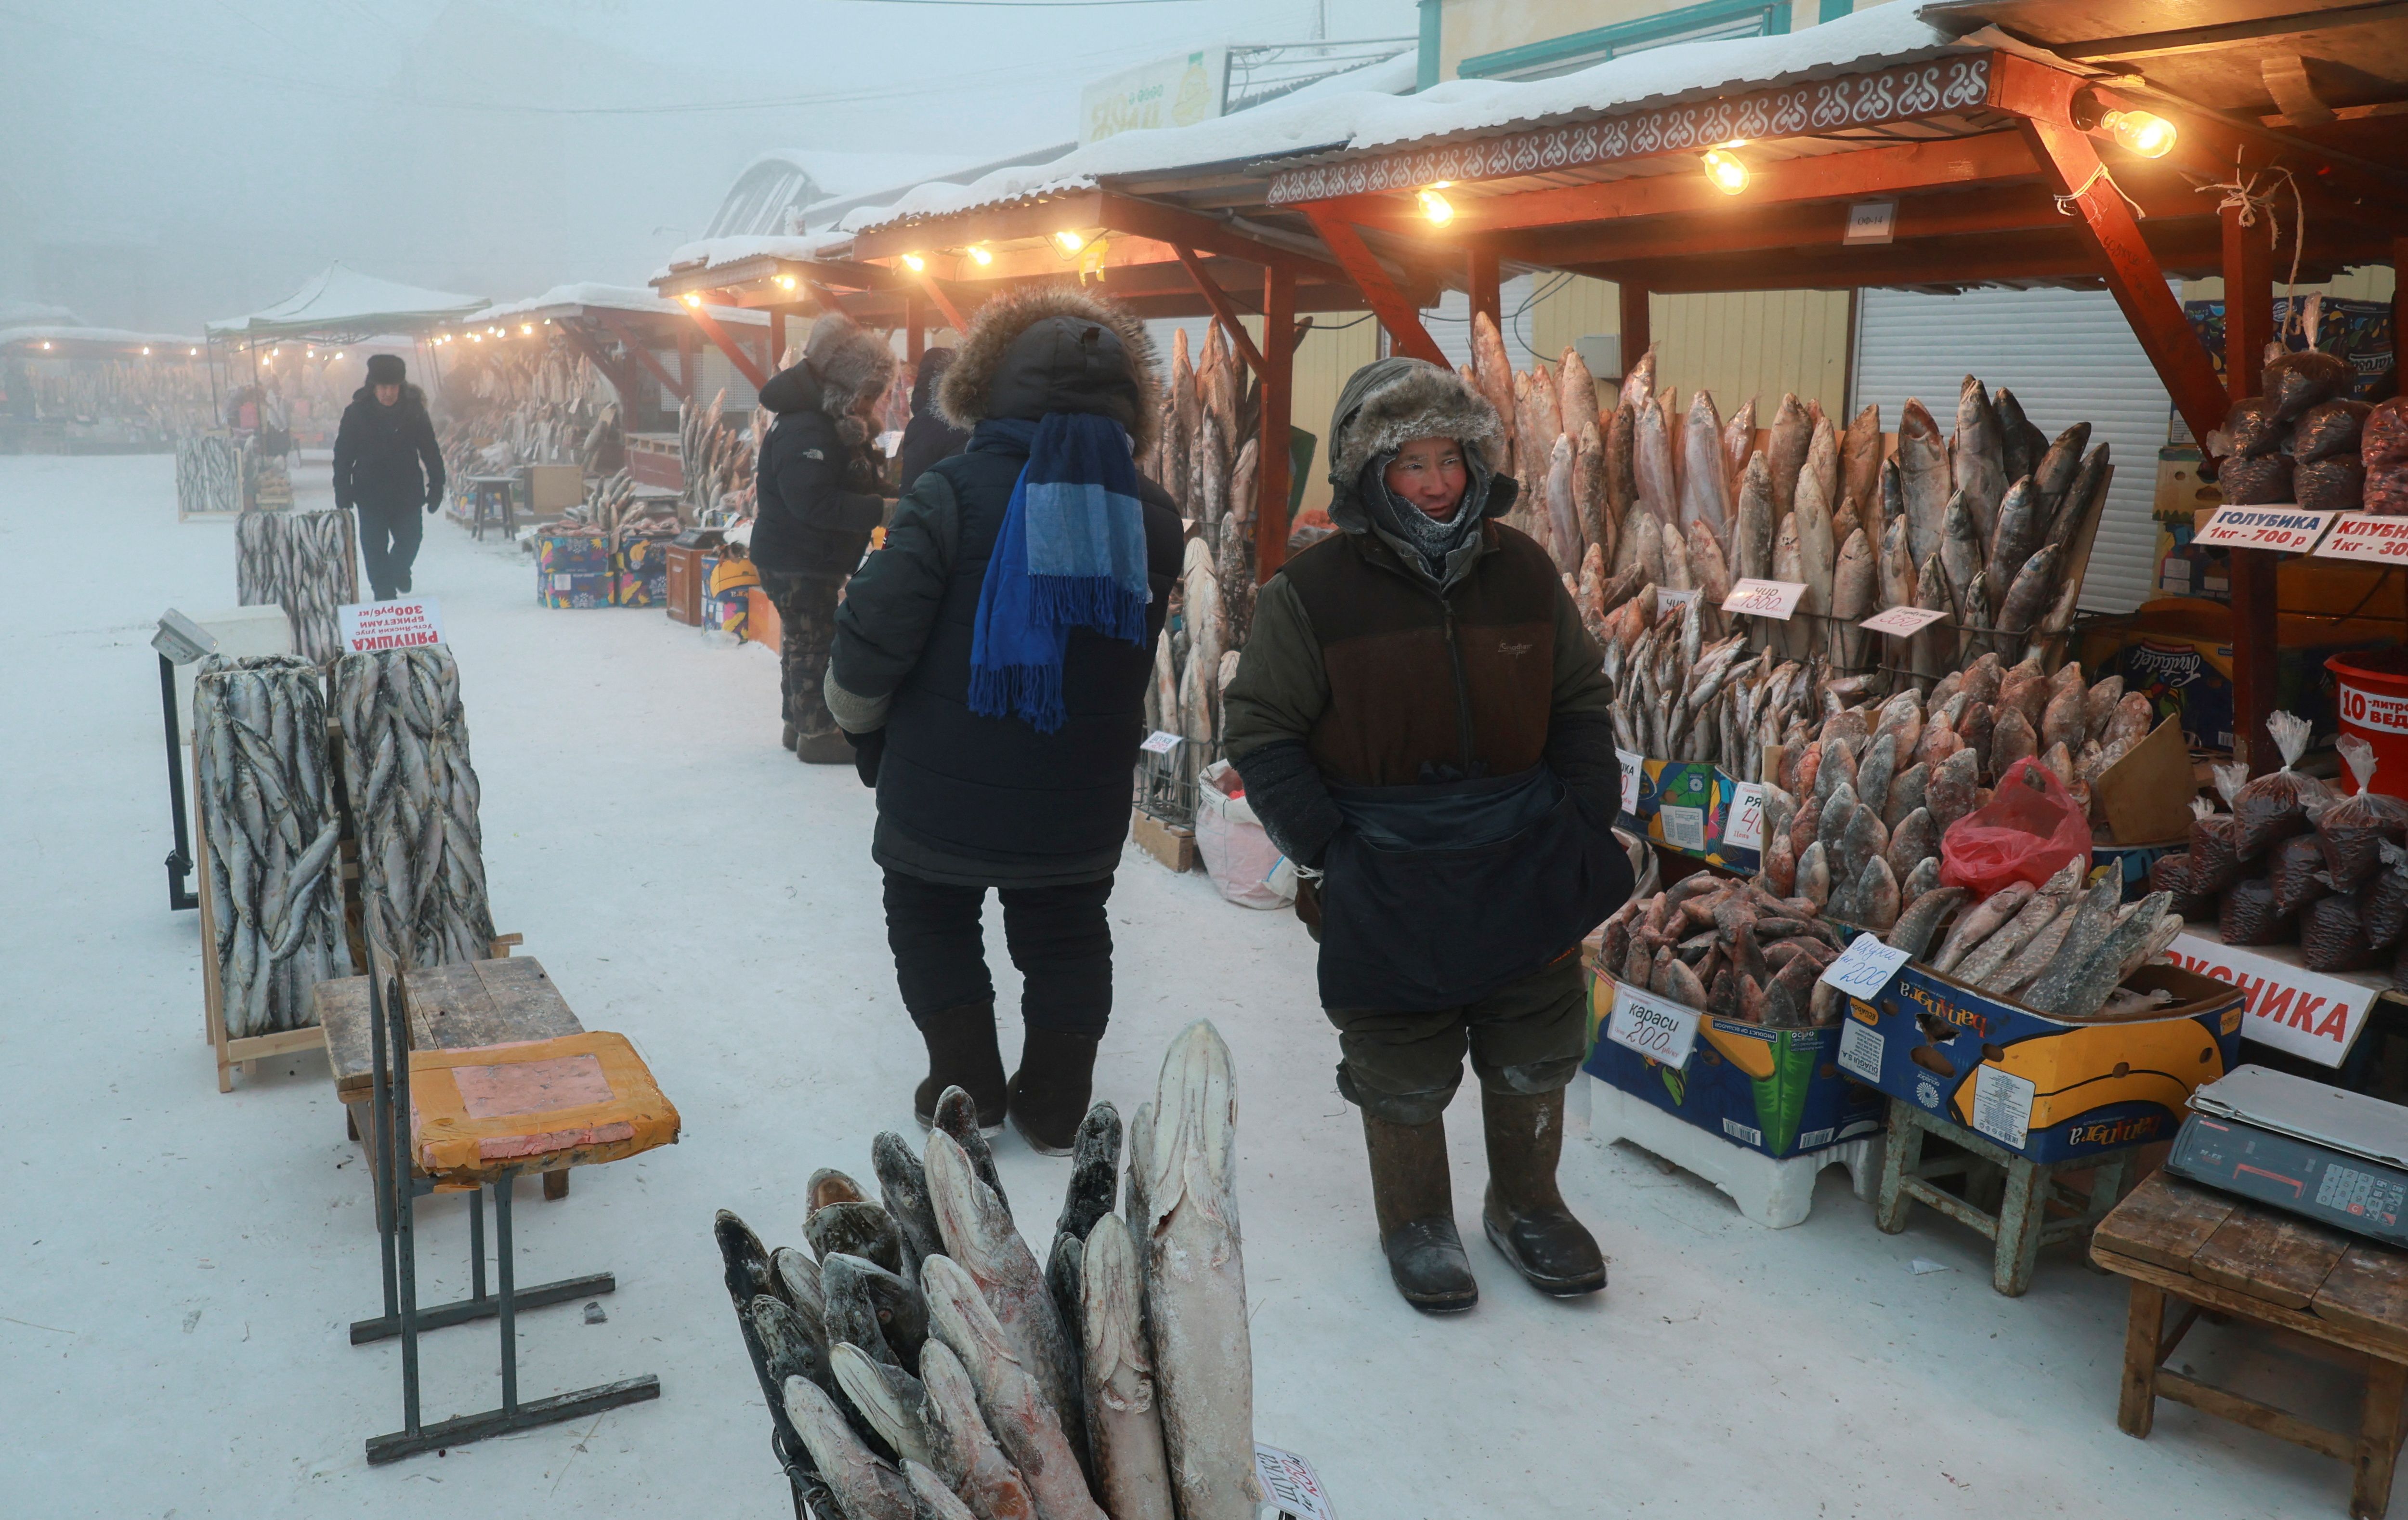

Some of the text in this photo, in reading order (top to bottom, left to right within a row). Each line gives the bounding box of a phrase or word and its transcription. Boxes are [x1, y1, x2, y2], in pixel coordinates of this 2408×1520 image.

[2217, 511, 2321, 530] ГОЛУБИКА
[2209, 526, 2239, 539] 1кг
[2250, 529, 2293, 544] 700
[2290, 536, 2306, 548] р
[2336, 521, 2408, 538] КЛУБН
[2331, 538, 2363, 552] 1кг
[2379, 541, 2408, 556] 30
[1755, 587, 1779, 598] чир
[1740, 594, 1781, 610] 1300
[357, 605, 423, 618] 300руб/кг
[355, 624, 432, 636] Усть-Янский улус
[359, 616, 424, 629] БРИКЕТАМИ
[351, 630, 439, 652] РЯПУШКА
[2343, 690, 2366, 721] 10
[1629, 1003, 1679, 1032] караси
[1626, 1021, 1670, 1050] 200
[1714, 1022, 1740, 1032] ECUADOR
[1749, 1029, 1775, 1039] PRODUCT
[1853, 1056, 1878, 1074] DUAGUI
